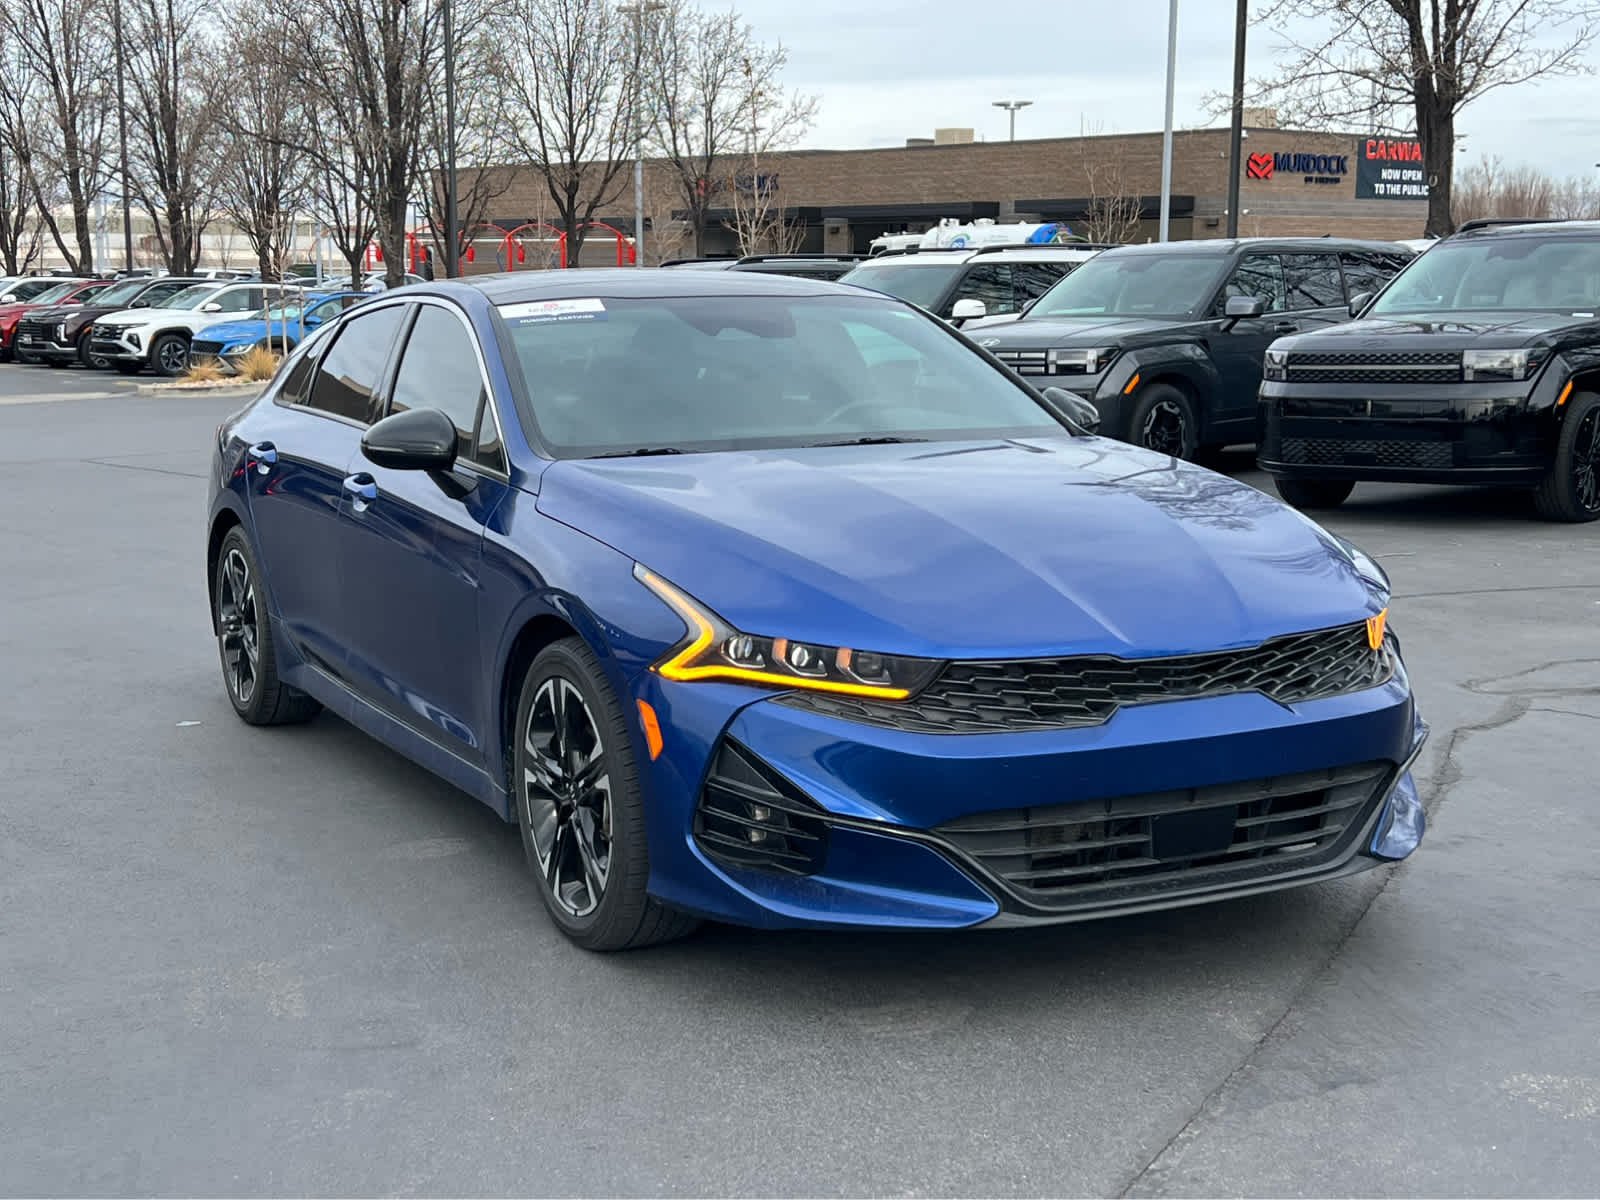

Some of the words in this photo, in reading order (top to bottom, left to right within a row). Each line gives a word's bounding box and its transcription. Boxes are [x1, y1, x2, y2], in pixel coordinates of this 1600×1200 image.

[1366, 139, 1422, 160] CARWA
[1274, 153, 1348, 174] MURDOCK
[1381, 168, 1401, 180] NOW
[1402, 169, 1422, 181] OPEN
[1374, 183, 1385, 195] TO
[1386, 184, 1401, 195] THE
[1402, 184, 1429, 196] PUBLIC
